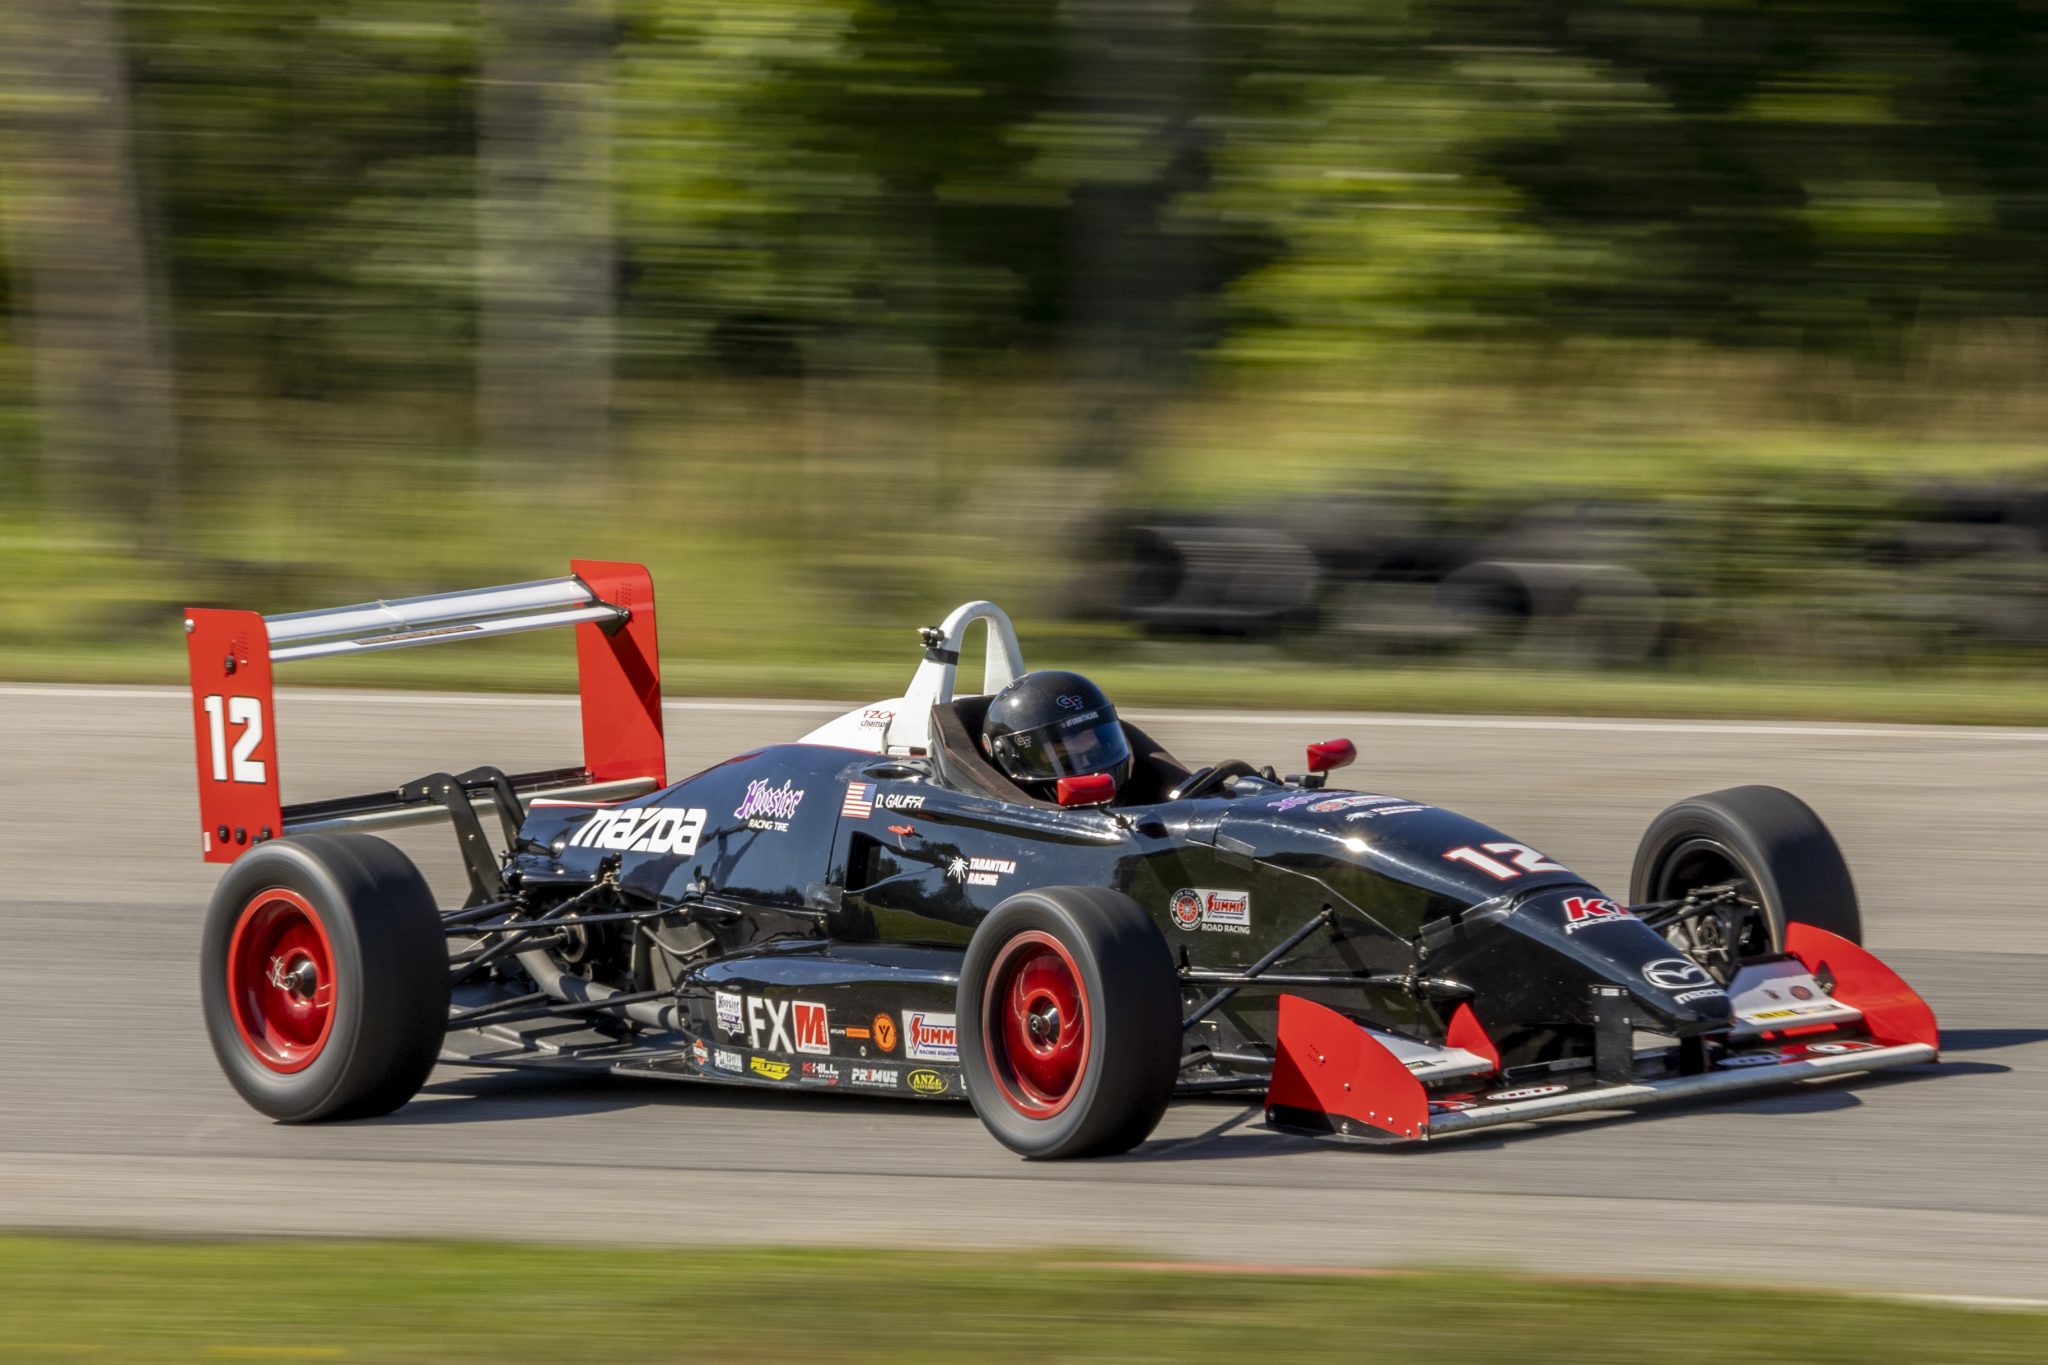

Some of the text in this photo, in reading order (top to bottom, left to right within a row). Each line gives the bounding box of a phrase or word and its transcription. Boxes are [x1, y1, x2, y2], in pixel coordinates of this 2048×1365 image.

[204, 695, 266, 784] 12
[734, 778, 804, 820] Hoosier
[875, 794, 926, 809] D. GALIFFA
[748, 819, 789, 832] RACING TIRE
[969, 857, 1017, 875] TARANTULA
[1442, 842, 1571, 881] 12
[966, 872, 999, 887] RACING
[1206, 892, 1247, 919] SUMMIT
[1201, 923, 1250, 935] ROAD RACING
[747, 995, 795, 1054] FX
[909, 1013, 959, 1056] SUMMI
